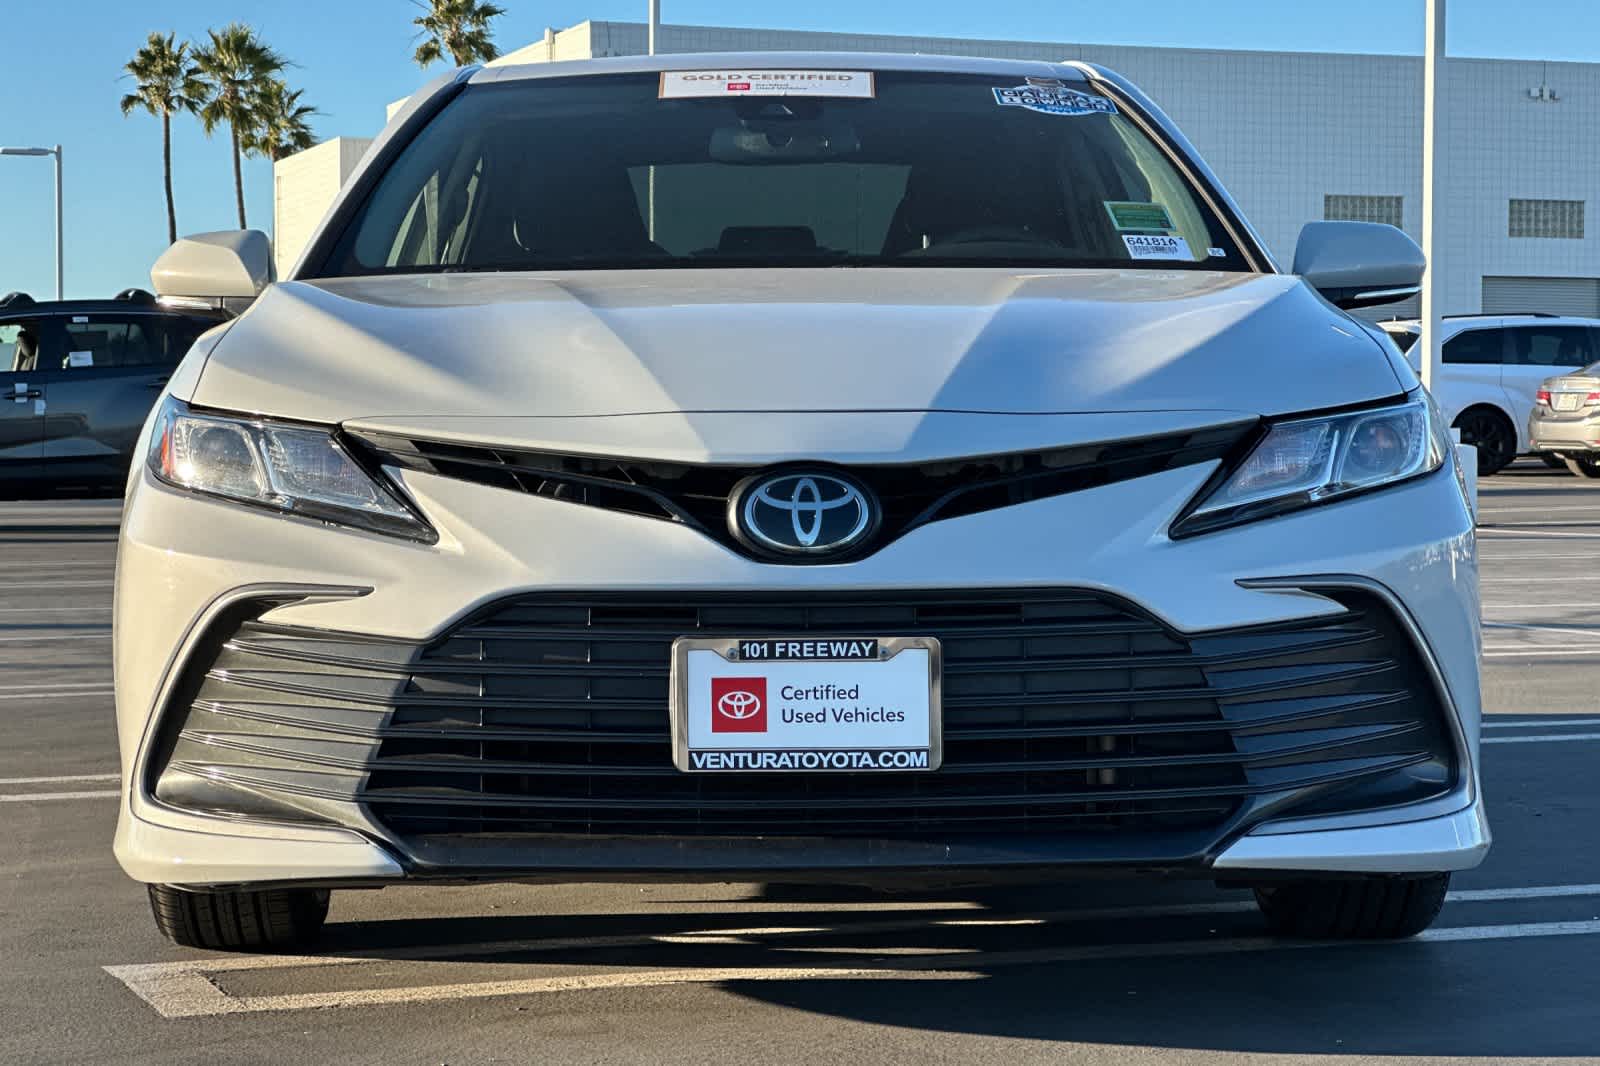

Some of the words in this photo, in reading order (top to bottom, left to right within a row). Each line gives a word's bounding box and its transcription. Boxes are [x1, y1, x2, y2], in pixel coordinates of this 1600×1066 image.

[747, 73, 853, 81] CERTIFIED
[1126, 236, 1178, 246] 64181A
[742, 642, 768, 658] 101
[775, 641, 874, 657] FREEWAY
[781, 684, 859, 701] Certified
[781, 707, 826, 724] Used
[831, 706, 905, 723] Vehicles
[691, 751, 928, 769] VENTURATOYOTA.COM
